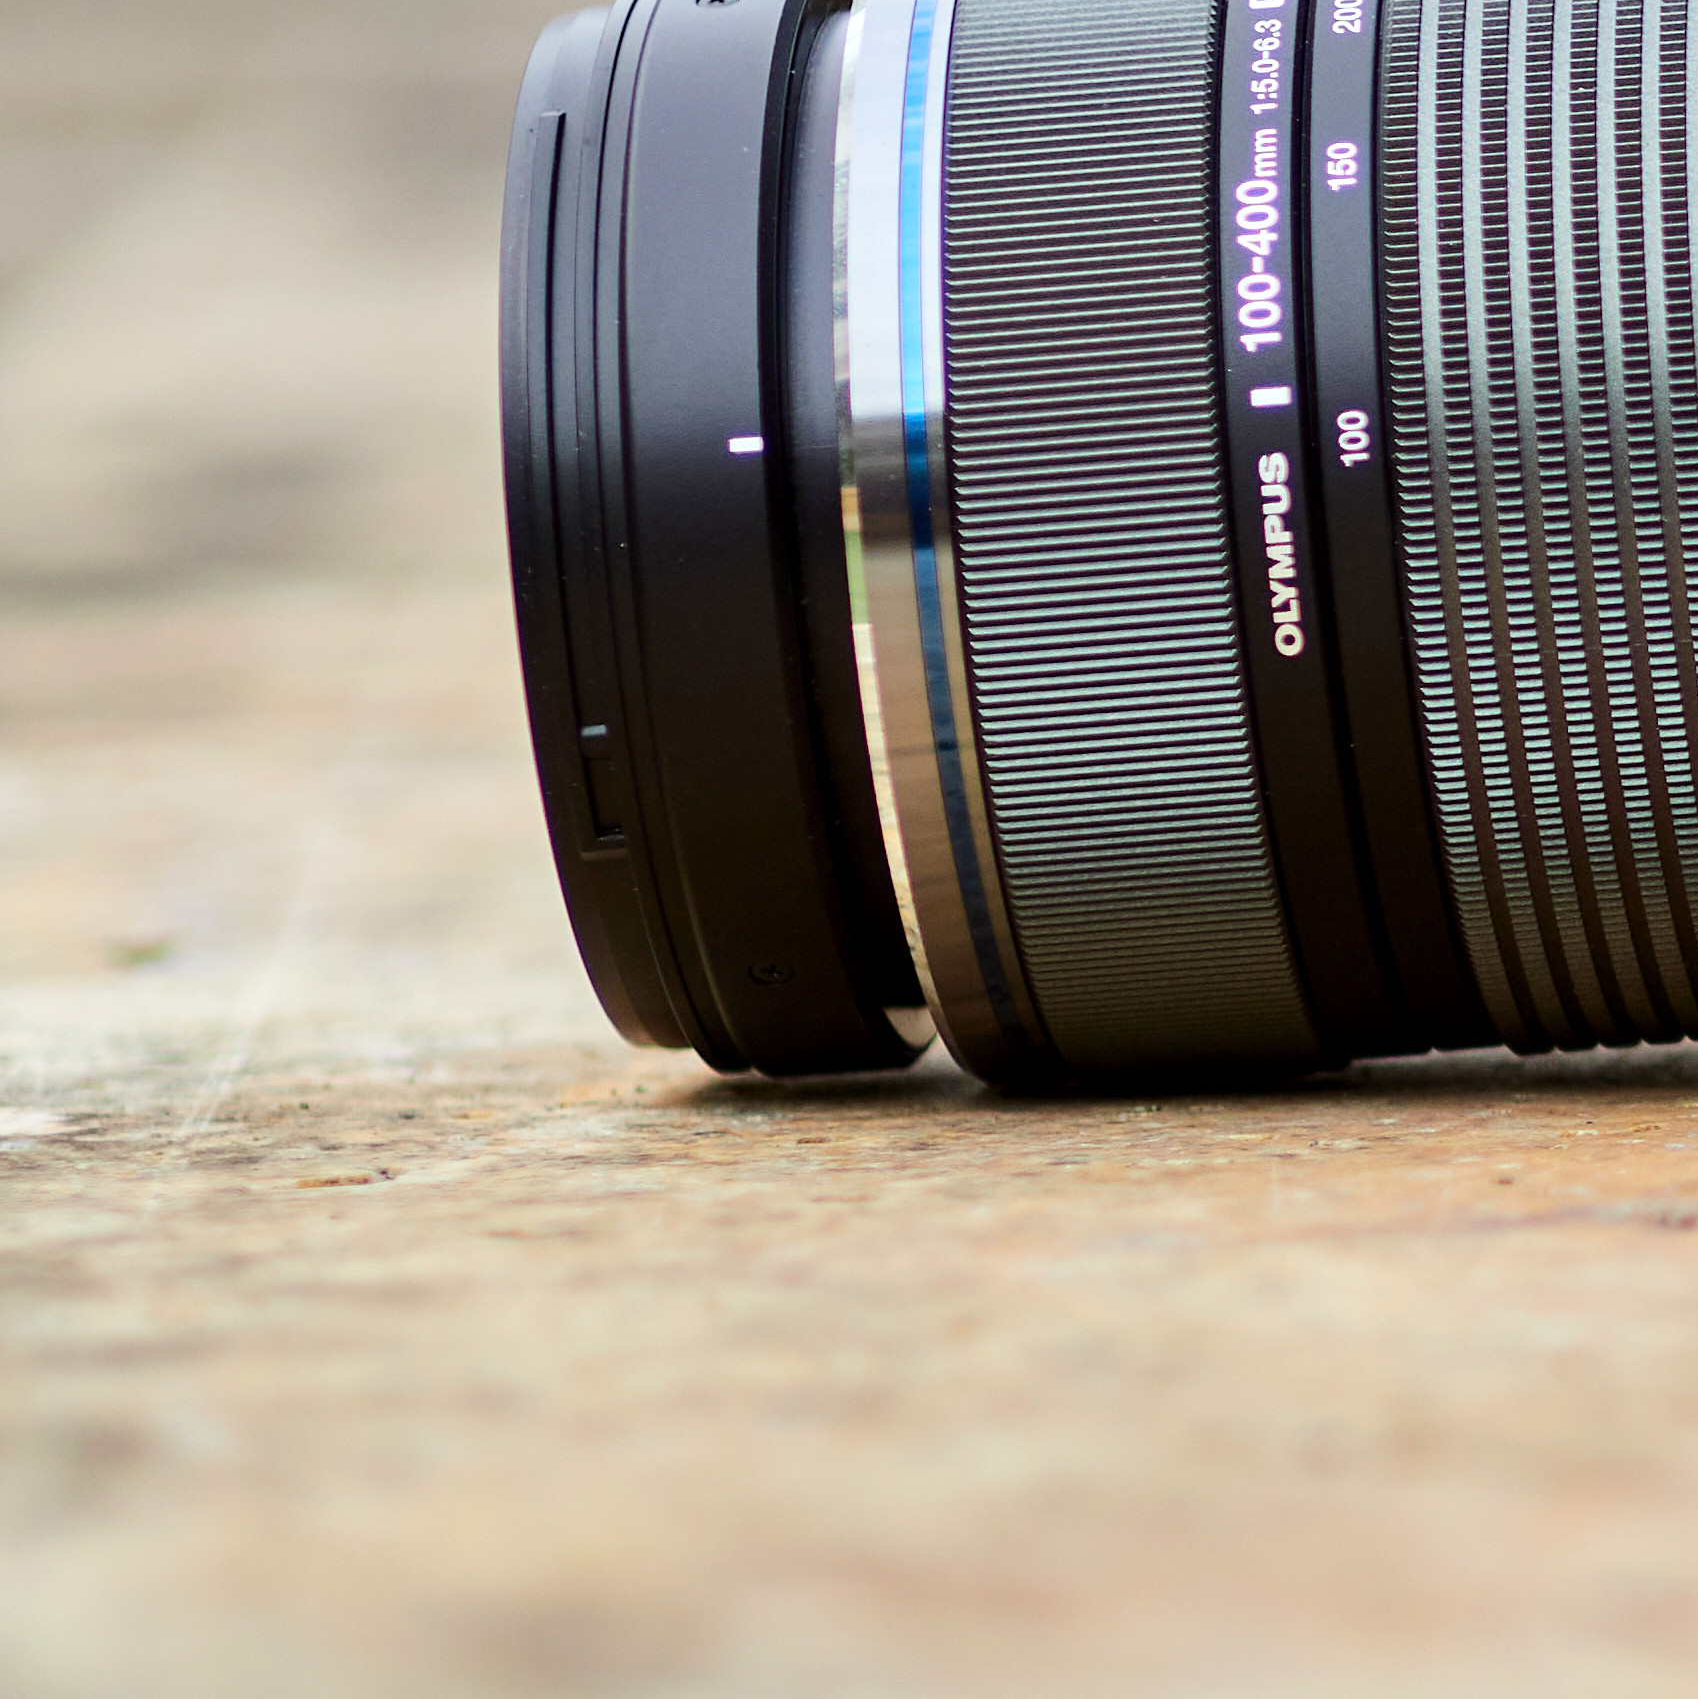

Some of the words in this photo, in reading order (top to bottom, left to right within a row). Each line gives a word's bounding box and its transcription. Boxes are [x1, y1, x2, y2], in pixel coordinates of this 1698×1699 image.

[1250, 18, 1282, 115] 1:5.0-6.3
[1326, 142, 1358, 192] 150
[1235, 128, 1283, 353] 100-400mm
[1336, 409, 1371, 468] 100
[1258, 452, 1305, 657] OLYMPUS
